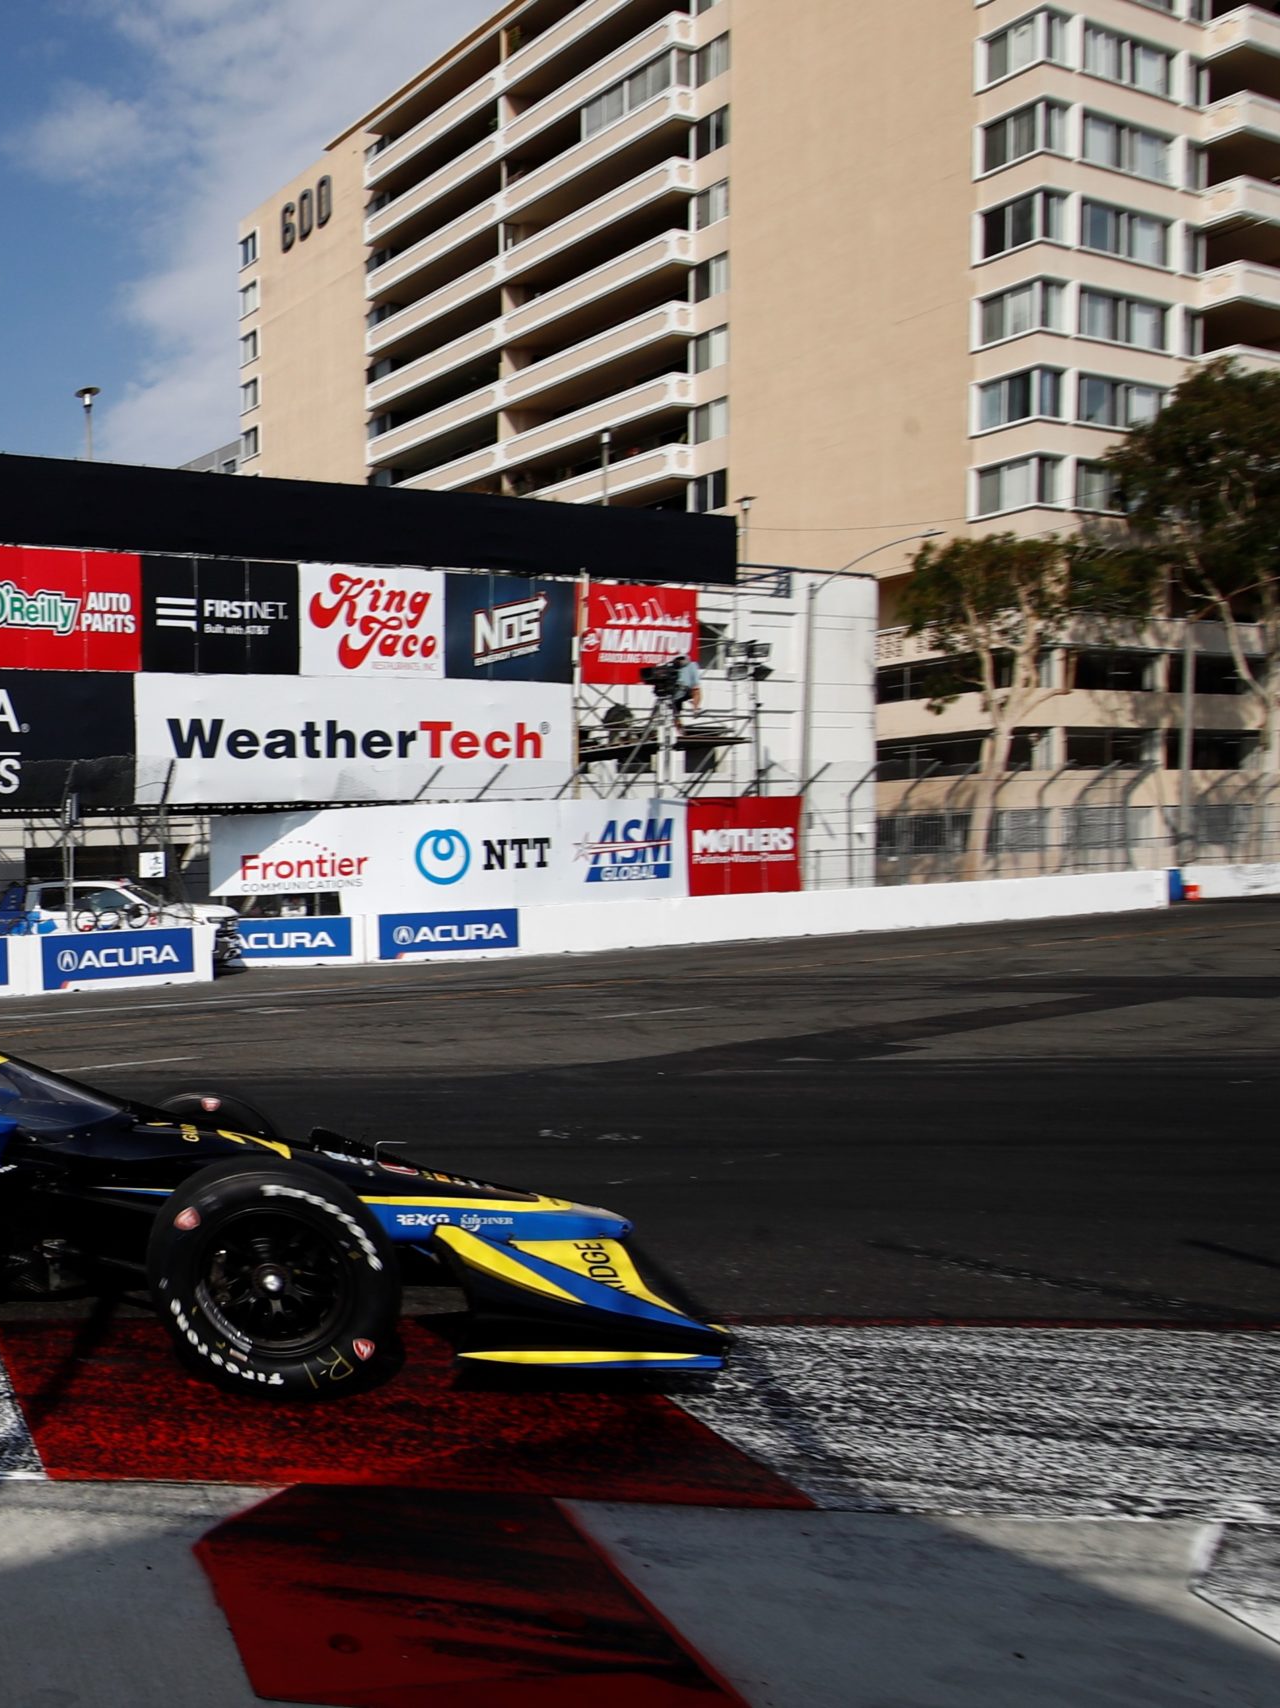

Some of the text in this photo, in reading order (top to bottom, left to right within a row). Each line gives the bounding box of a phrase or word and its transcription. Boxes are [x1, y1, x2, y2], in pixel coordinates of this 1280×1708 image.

[281, 175, 332, 254] 600
[86, 592, 131, 612] AUTO
[309, 573, 432, 629] King
[80, 613, 135, 633] PARTS
[204, 624, 270, 635] Built with AT&T
[474, 594, 546, 654] NOS
[338, 616, 436, 670] Taco
[600, 628, 692, 654] MANITOU
[598, 652, 641, 662] HANDLING
[168, 718, 542, 759] WeatherTech
[592, 818, 674, 865] ASM
[693, 828, 794, 853] MOTHERS
[482, 837, 552, 870] NTT
[240, 852, 368, 881] Frontier
[600, 866, 657, 882] GLOBAL
[241, 878, 362, 893] COMMUNICATIONS
[414, 924, 508, 943] ACURA
[78, 945, 179, 969] ACURA
[396, 1214, 450, 1226] REXCO
